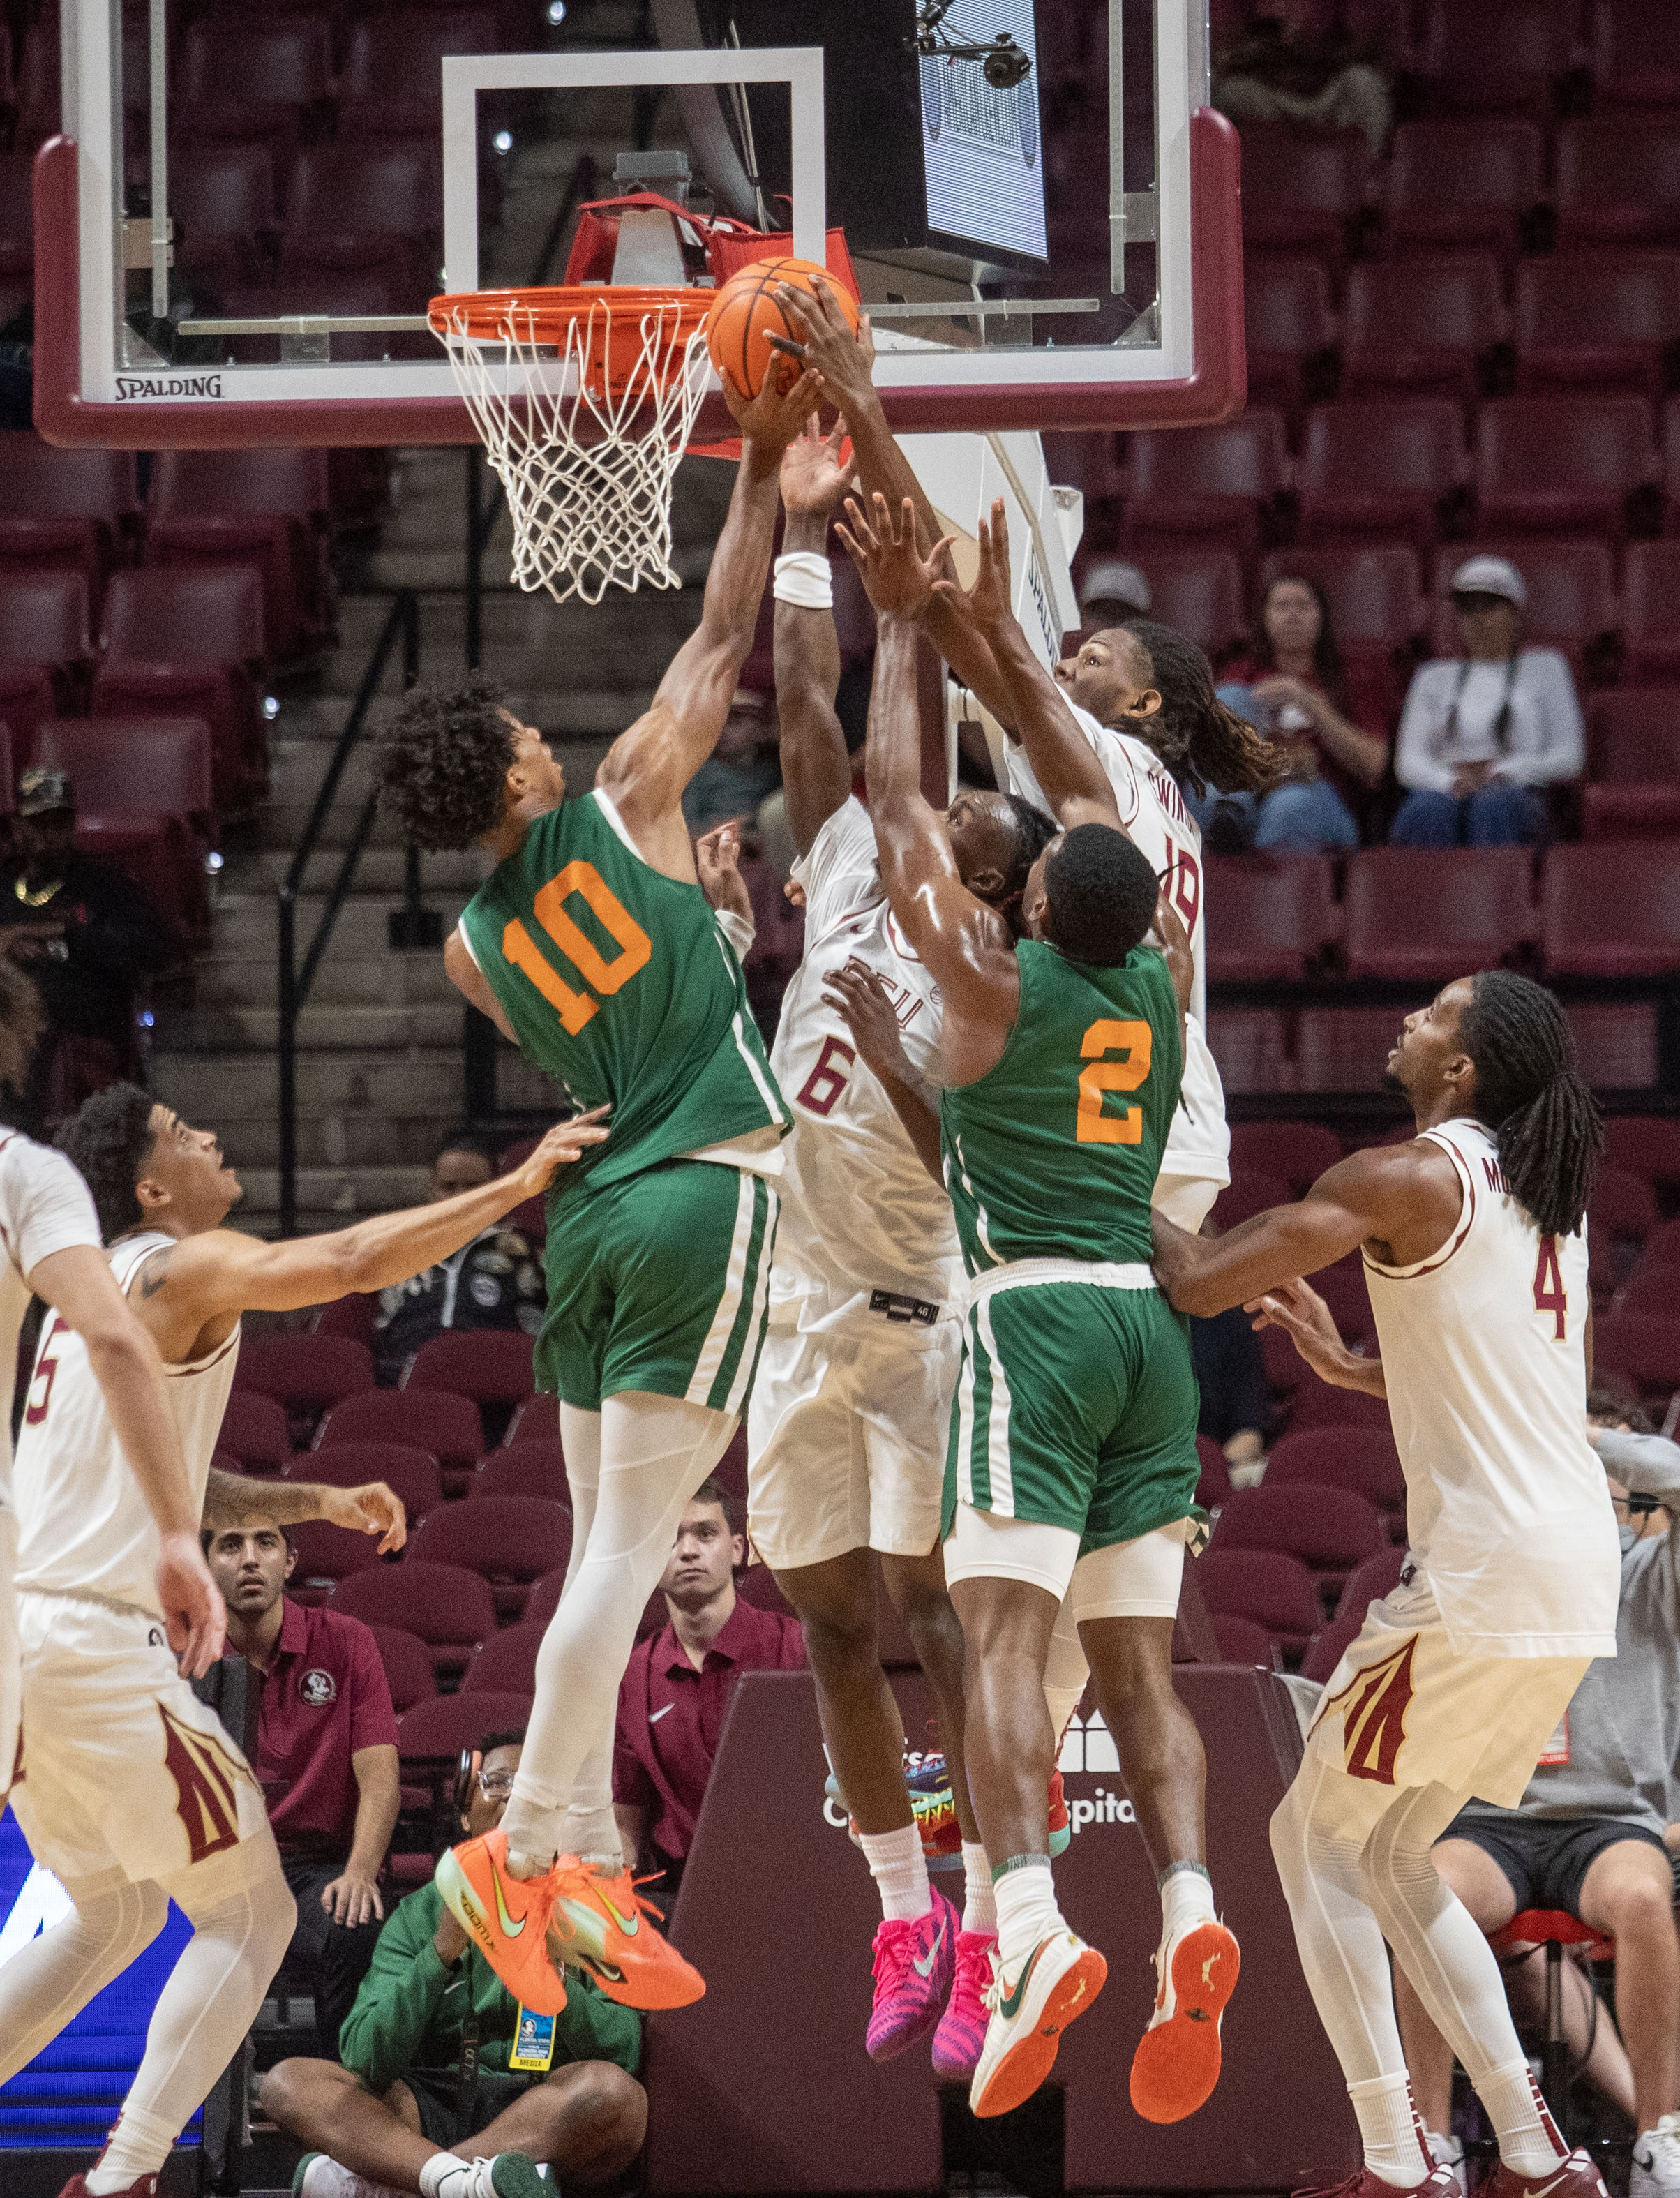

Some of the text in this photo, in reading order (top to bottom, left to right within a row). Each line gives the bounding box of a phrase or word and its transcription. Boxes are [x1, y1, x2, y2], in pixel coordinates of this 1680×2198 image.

[115, 375, 222, 401] SPALDING
[502, 860, 652, 1036] 10
[796, 1035, 857, 1116] 6
[1077, 1019, 1153, 1144] 2
[1533, 1233, 1567, 1341] 4
